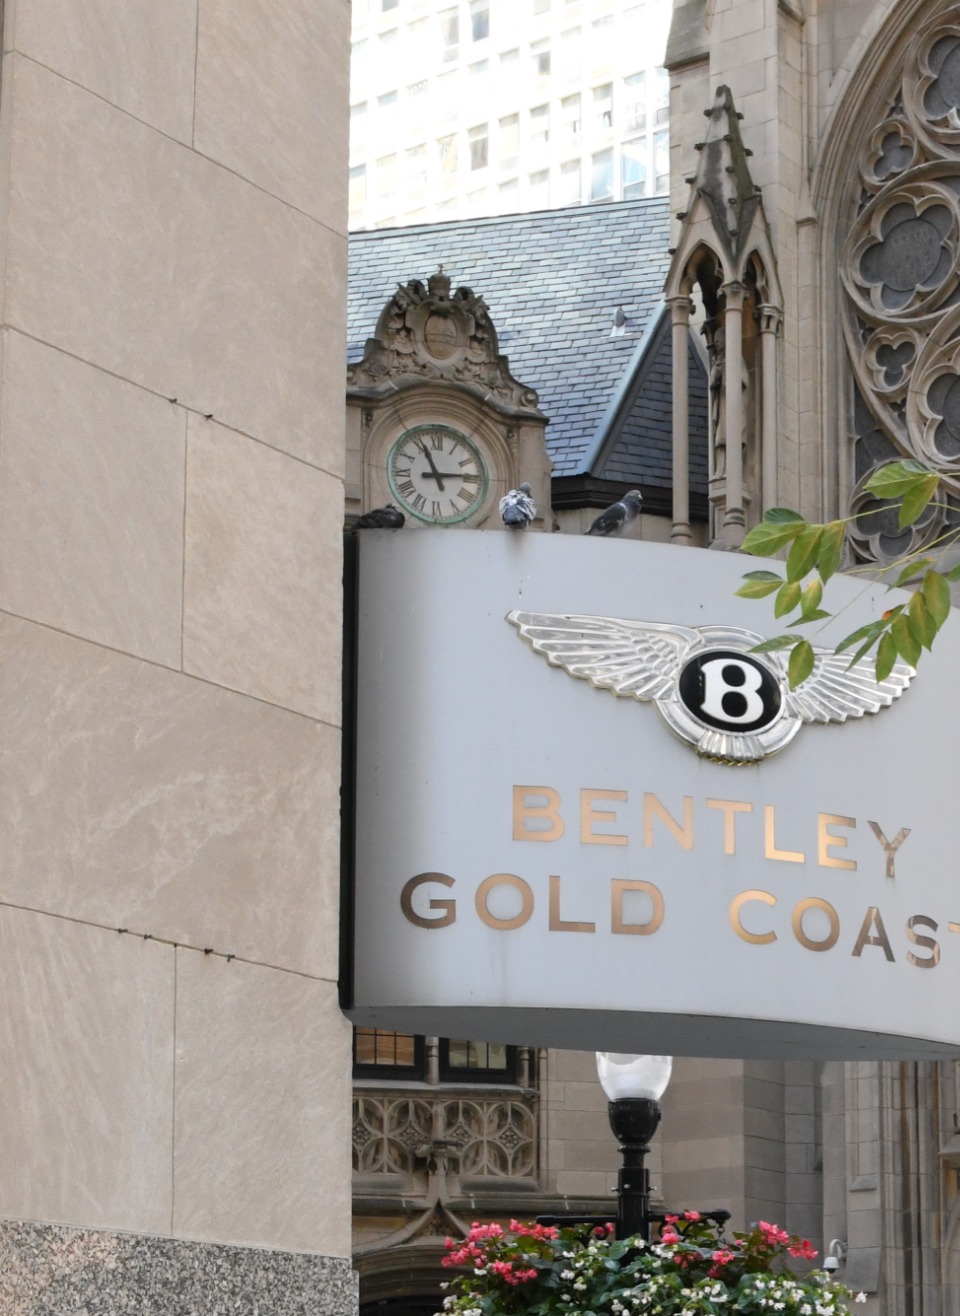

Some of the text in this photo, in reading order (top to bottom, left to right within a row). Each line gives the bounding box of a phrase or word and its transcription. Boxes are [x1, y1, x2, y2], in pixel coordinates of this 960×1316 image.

[700, 658, 764, 724] B
[512, 784, 912, 878] BENTLEY
[400, 872, 665, 936] GOLD
